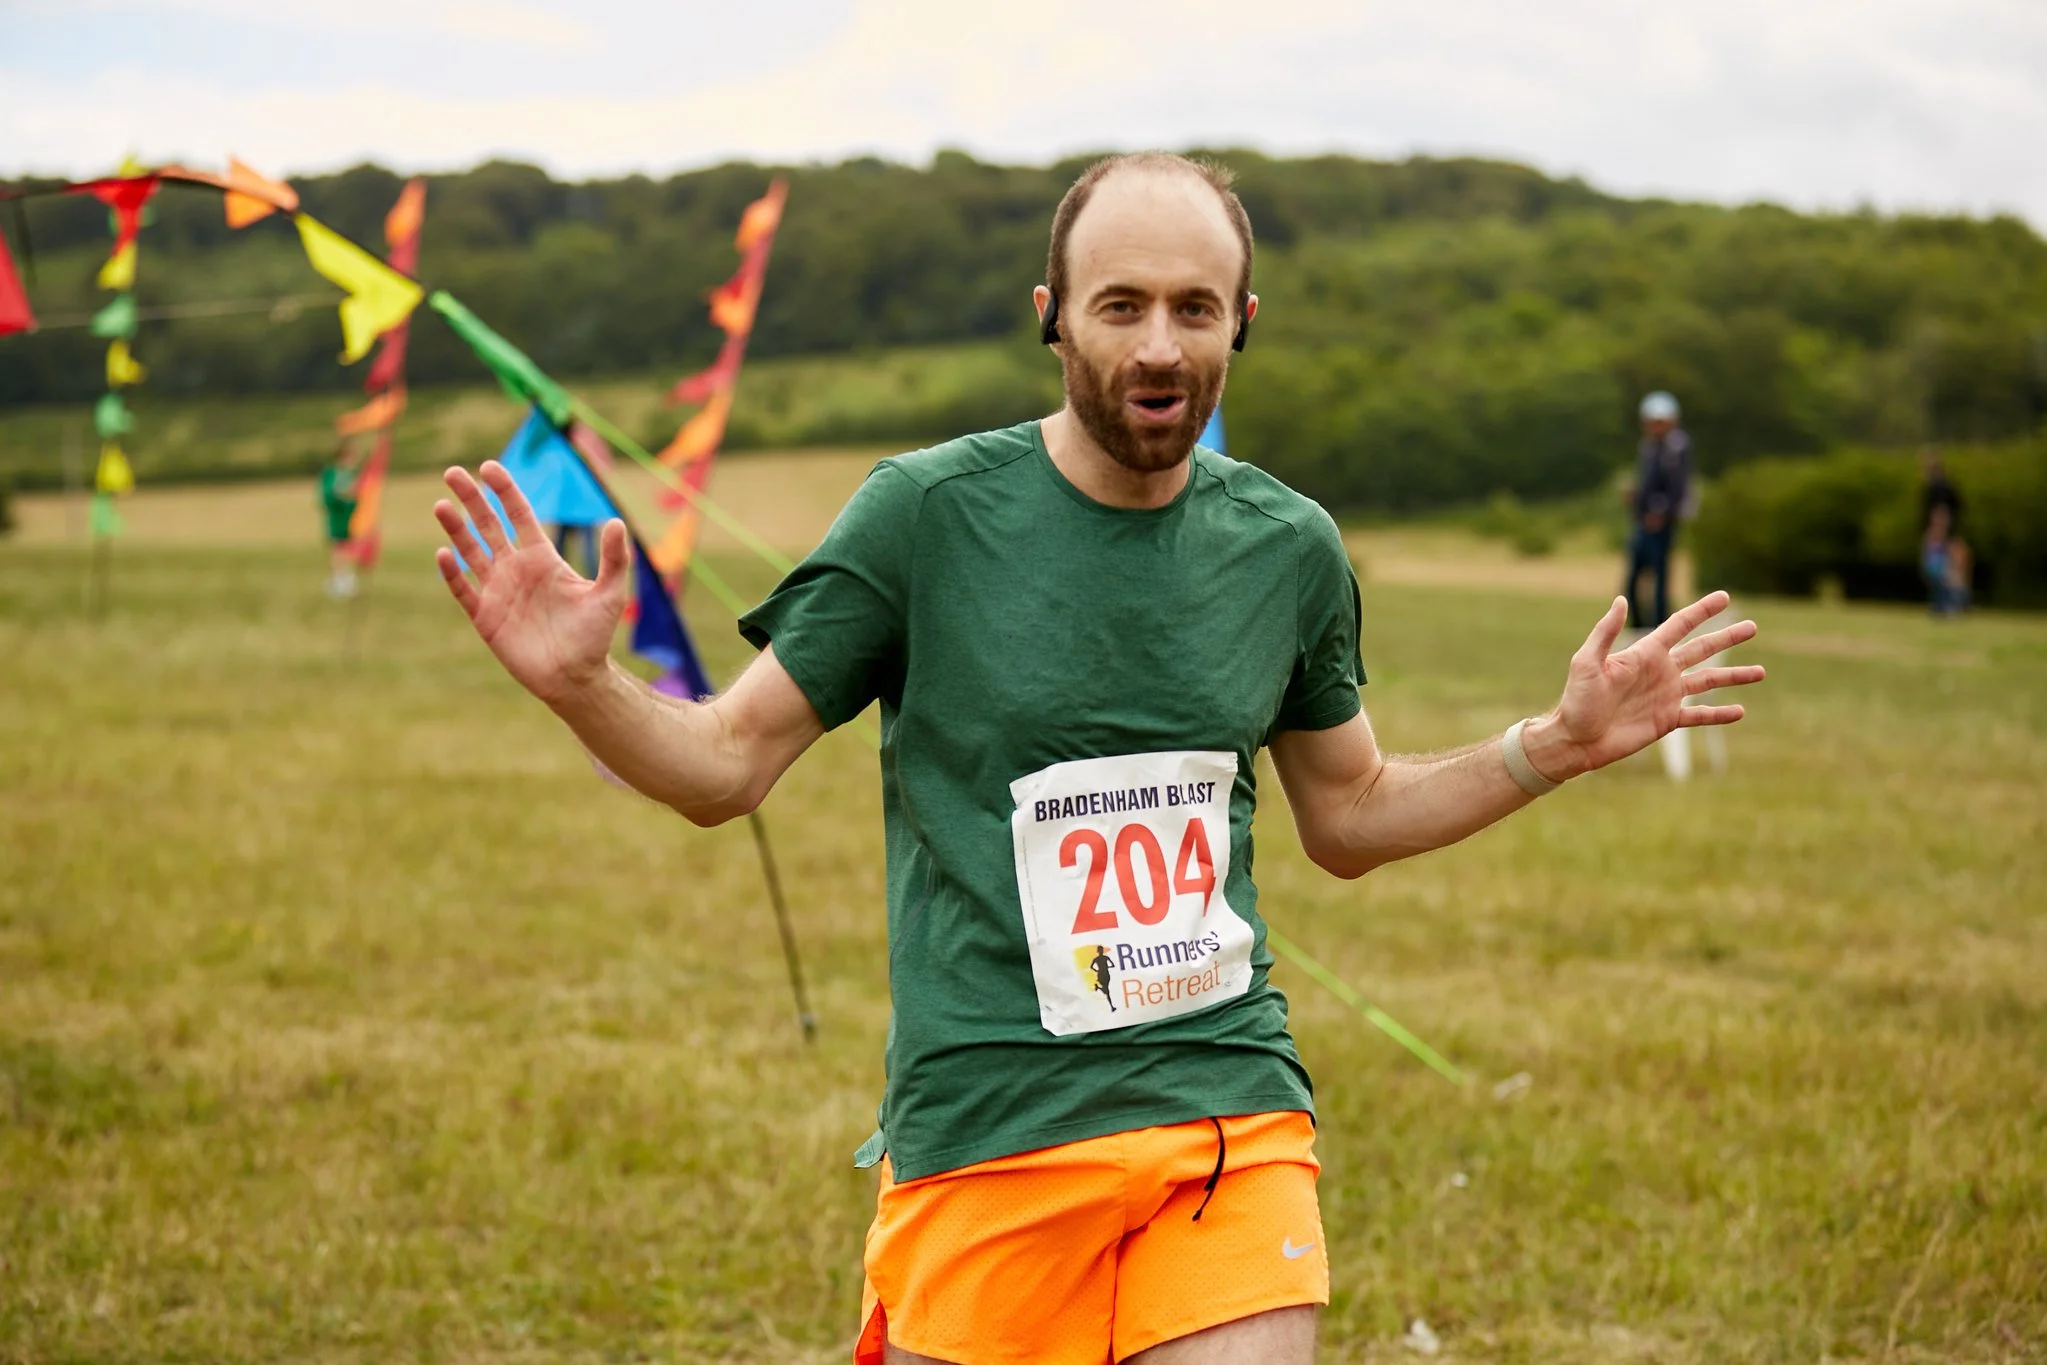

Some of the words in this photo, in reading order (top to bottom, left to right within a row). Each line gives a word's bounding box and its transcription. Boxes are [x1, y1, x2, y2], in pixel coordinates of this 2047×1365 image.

[1035, 786, 1159, 822] BRADENHAM
[1167, 782, 1216, 806] BLAST
[1059, 817, 1217, 935] 204
[1121, 961, 1221, 1008] Retreat
